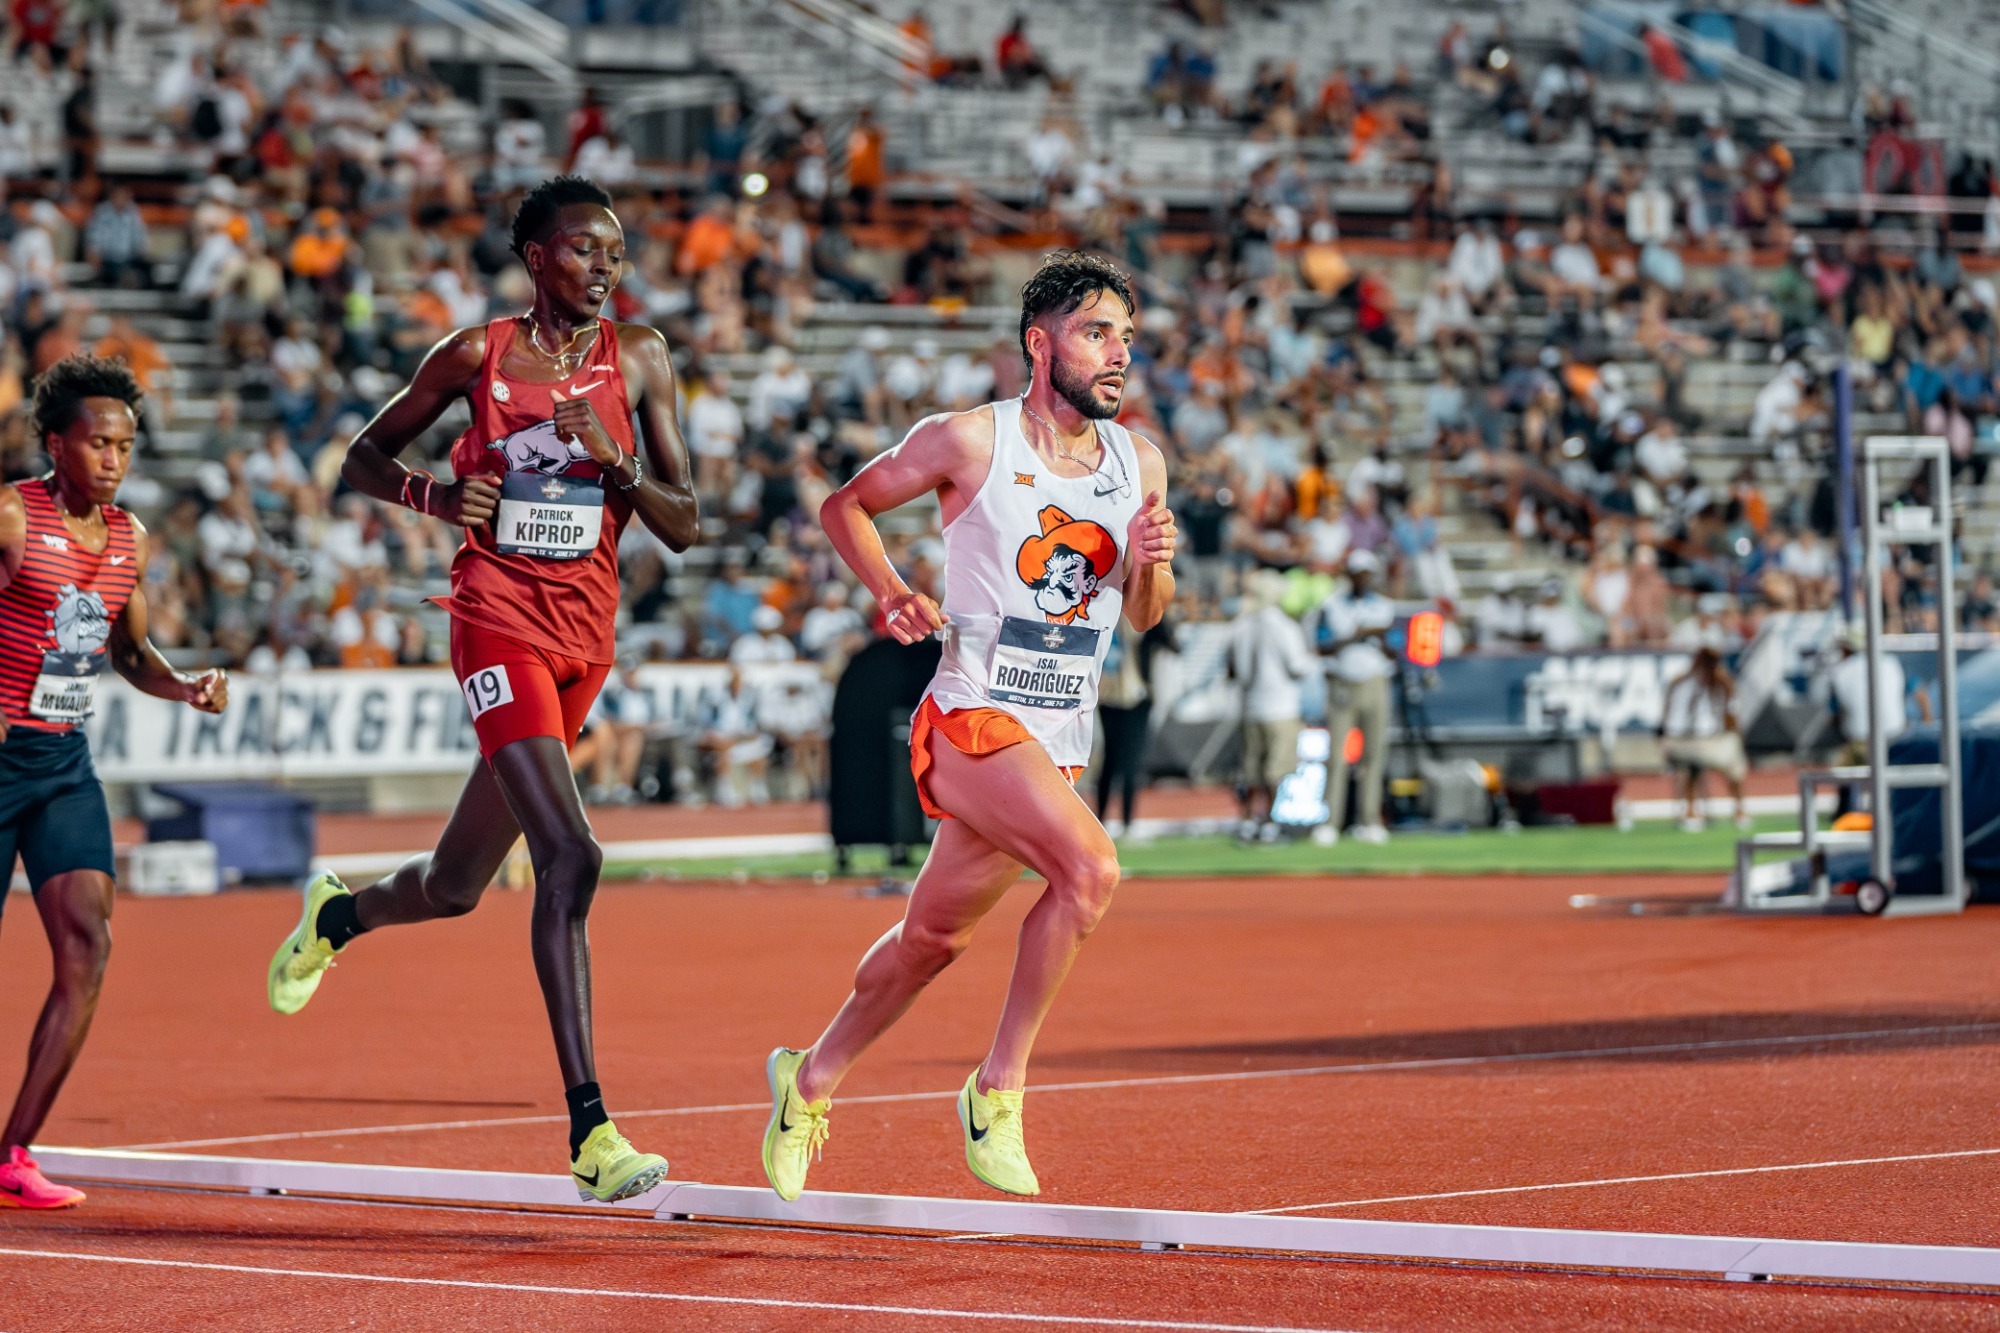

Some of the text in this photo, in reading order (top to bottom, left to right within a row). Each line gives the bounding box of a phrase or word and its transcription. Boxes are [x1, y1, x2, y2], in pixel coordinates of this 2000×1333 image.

[529, 508, 574, 521] PATRICK
[515, 521, 584, 545] KIPROP
[1036, 658, 1058, 670] ISAI
[467, 670, 501, 712] 19
[995, 665, 1085, 695] RODRIGUEZ
[356, 687, 387, 754] &
